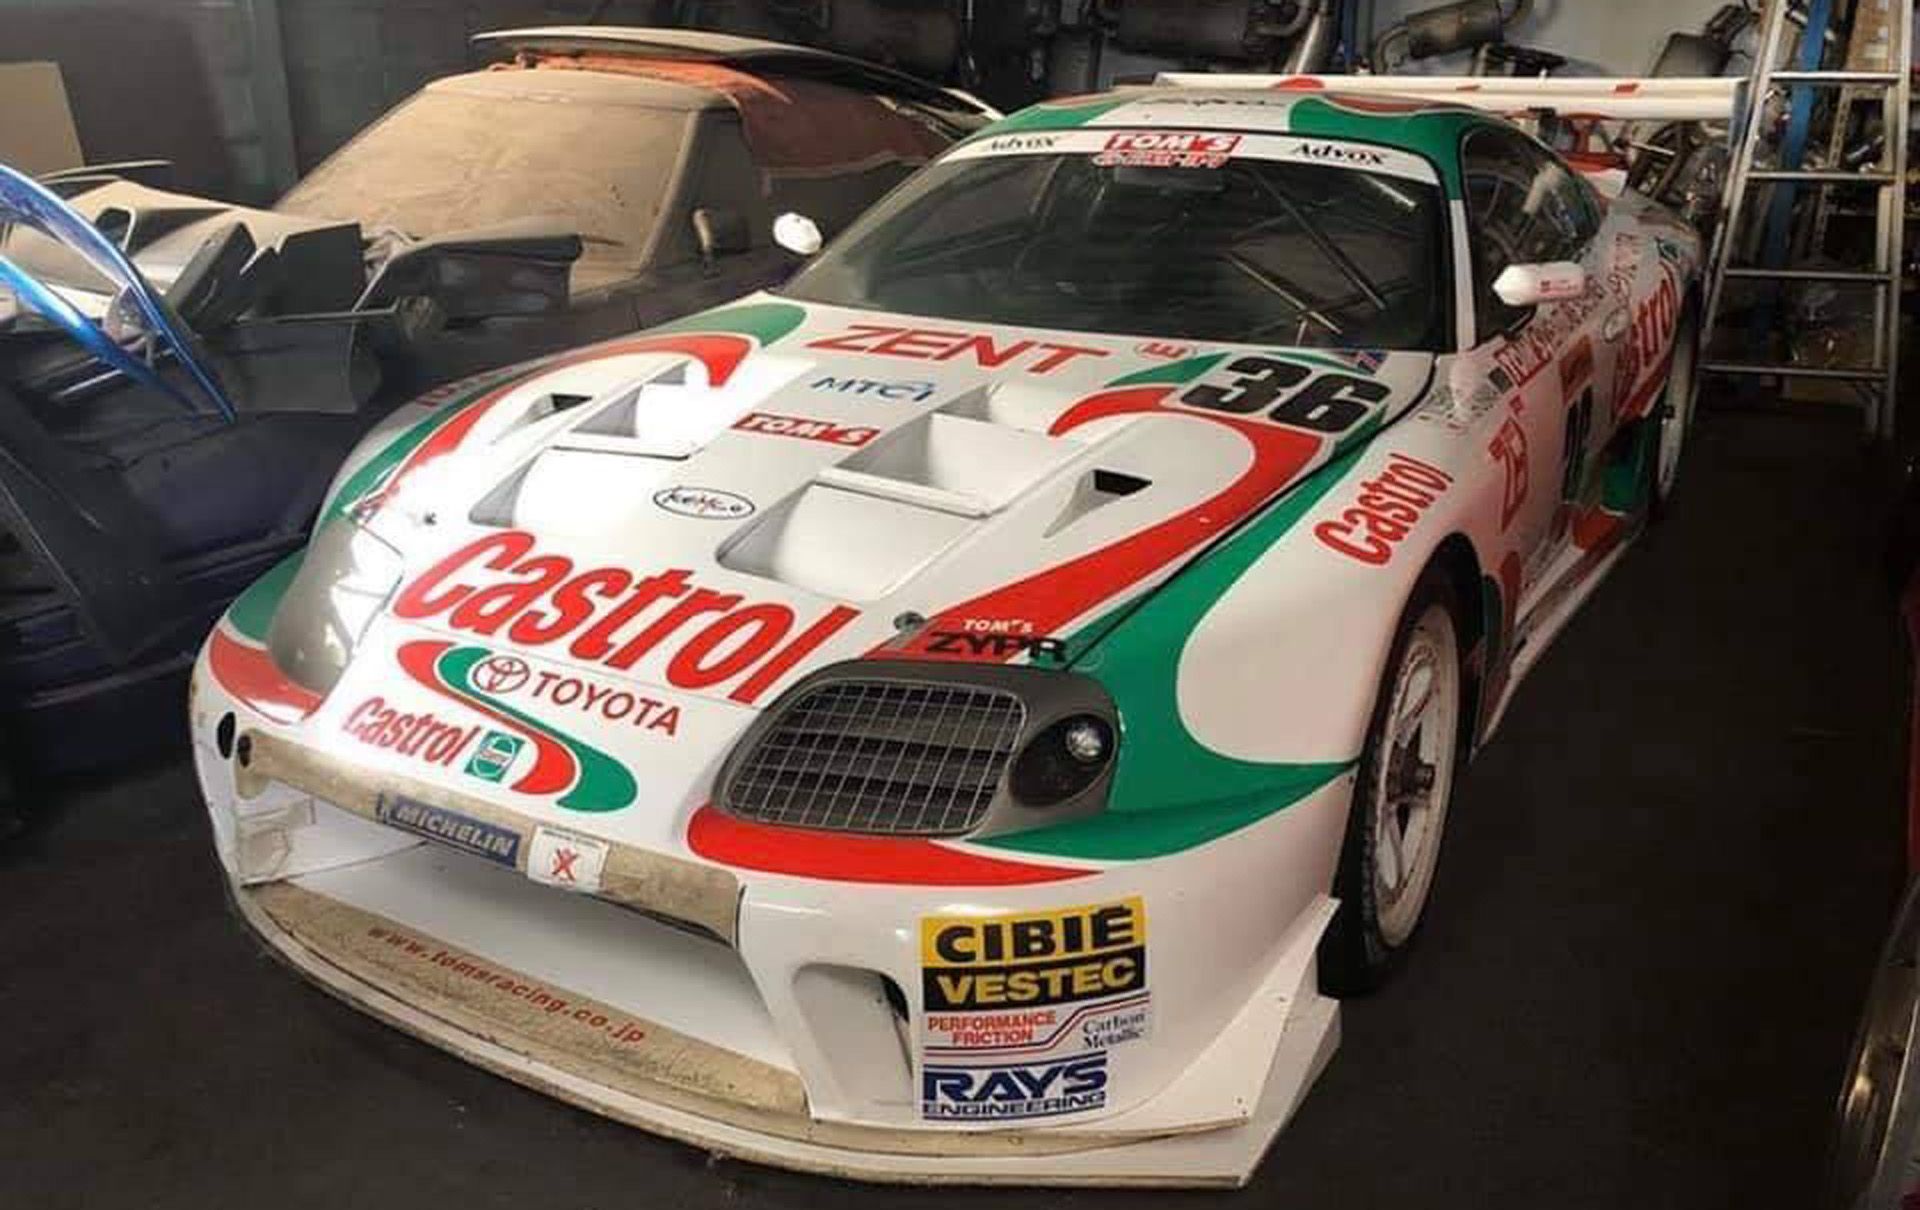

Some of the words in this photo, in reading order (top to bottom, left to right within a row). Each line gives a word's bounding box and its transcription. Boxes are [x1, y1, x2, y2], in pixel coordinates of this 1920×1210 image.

[1108, 133, 1238, 152] TOM'S
[1289, 142, 1387, 166] Advox
[804, 324, 1110, 375] ZENT
[1180, 356, 1392, 433] 36
[742, 414, 872, 446] TOM'S
[1314, 452, 1455, 566] Castrol
[392, 530, 864, 706] Castrol
[962, 618, 1034, 633] TOM'S
[925, 632, 1069, 663] ZYPR
[532, 670, 683, 737] TOYOTA
[341, 696, 478, 767] Castrol
[396, 803, 516, 858] MICHELIN
[935, 903, 1136, 964] CIBIÉ
[367, 925, 647, 1045] www.tomsracing.co.jp
[937, 957, 1137, 1005] VESTEC
[927, 1010, 1057, 1032] PERFORMANCE
[952, 1028, 1034, 1046] FRICTION
[1082, 1012, 1145, 1035] Carbon
[923, 1056, 1108, 1103] RAYS
[923, 1091, 1105, 1116] ENGINEERING
